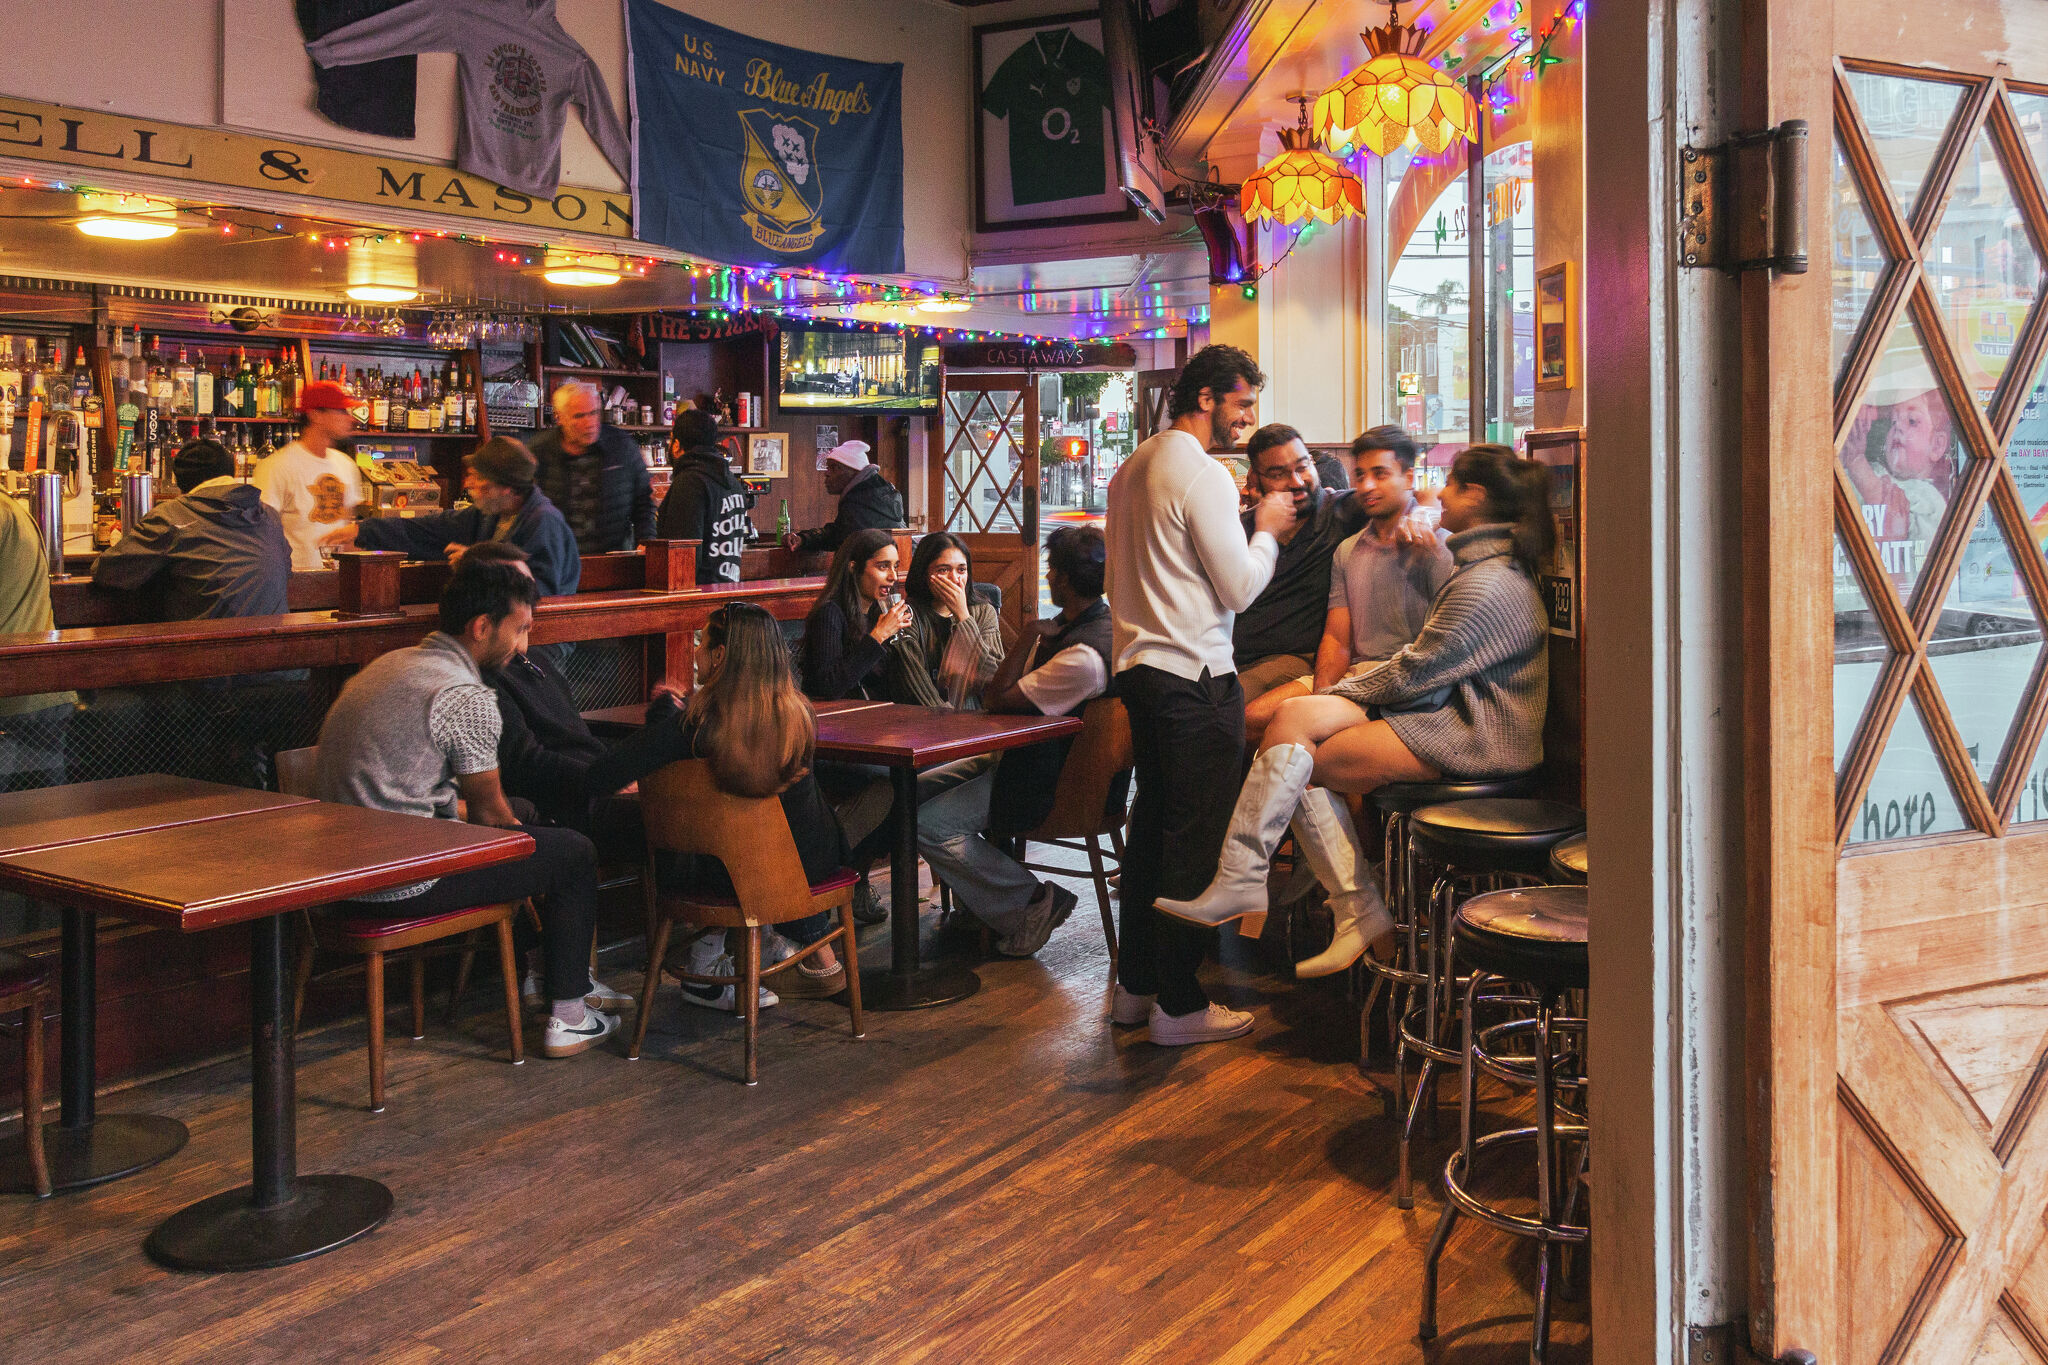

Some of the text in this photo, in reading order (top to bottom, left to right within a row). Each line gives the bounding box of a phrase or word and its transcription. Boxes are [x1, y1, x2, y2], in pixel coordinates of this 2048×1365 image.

[684, 34, 718, 61] U.S.
[675, 53, 725, 86] NAVY
[744, 57, 872, 125] Blue Angels
[258, 149, 314, 184] &
[376, 166, 633, 227] MASON
[755, 225, 814, 249] BLUE ANGELS
[647, 312, 690, 339] THE
[987, 348, 1083, 364] CASTAWAYS
[86, 416, 100, 425] IPA
[1862, 504, 1886, 537] RY
